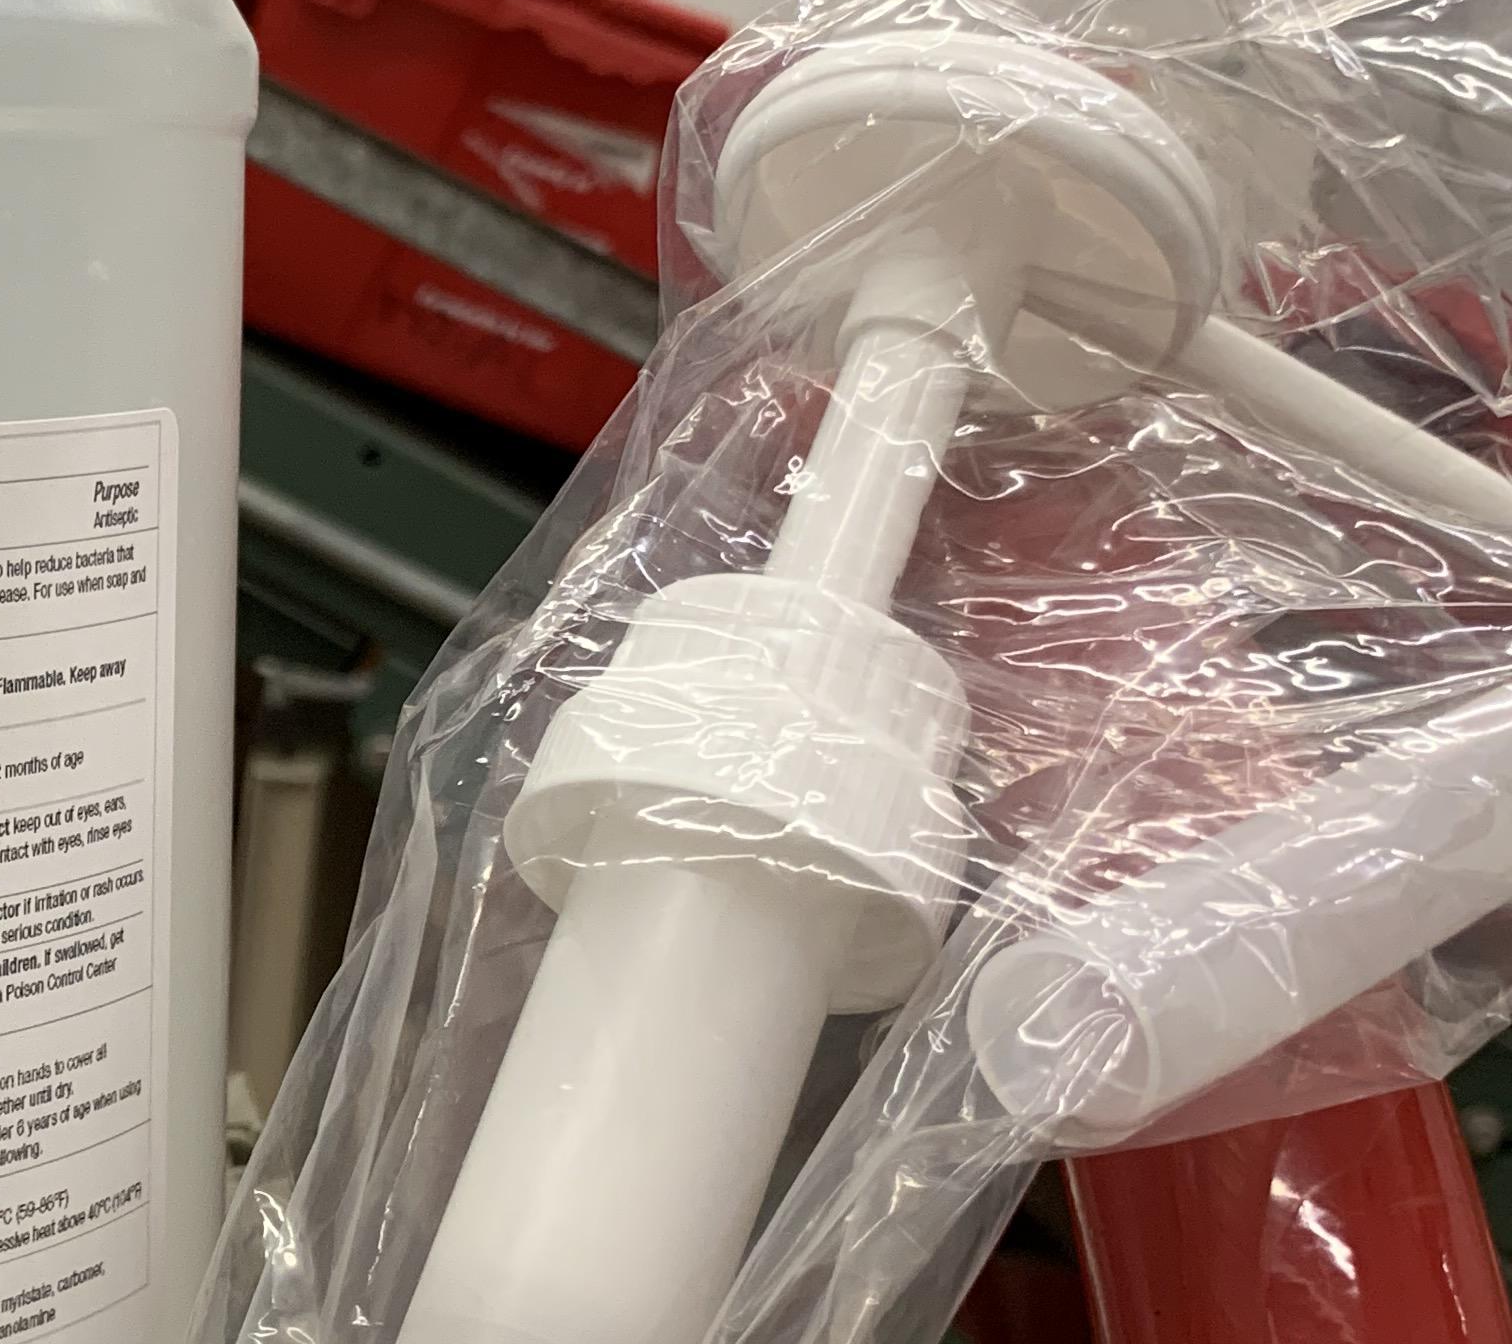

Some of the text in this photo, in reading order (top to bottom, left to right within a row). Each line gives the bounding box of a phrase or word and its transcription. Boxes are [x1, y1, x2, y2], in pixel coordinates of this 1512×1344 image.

[93, 480, 140, 506] Purpose
[93, 506, 139, 529] Antiseptic
[6, 558, 33, 580] help
[34, 554, 73, 575] reduce
[75, 547, 115, 570] bacteria
[33, 581, 53, 601] For
[55, 580, 75, 598] use
[69, 665, 97, 685] Keep
[99, 658, 127, 678] away
[4, 756, 49, 779] months
[50, 751, 62, 771] of
[63, 750, 84, 770] age
